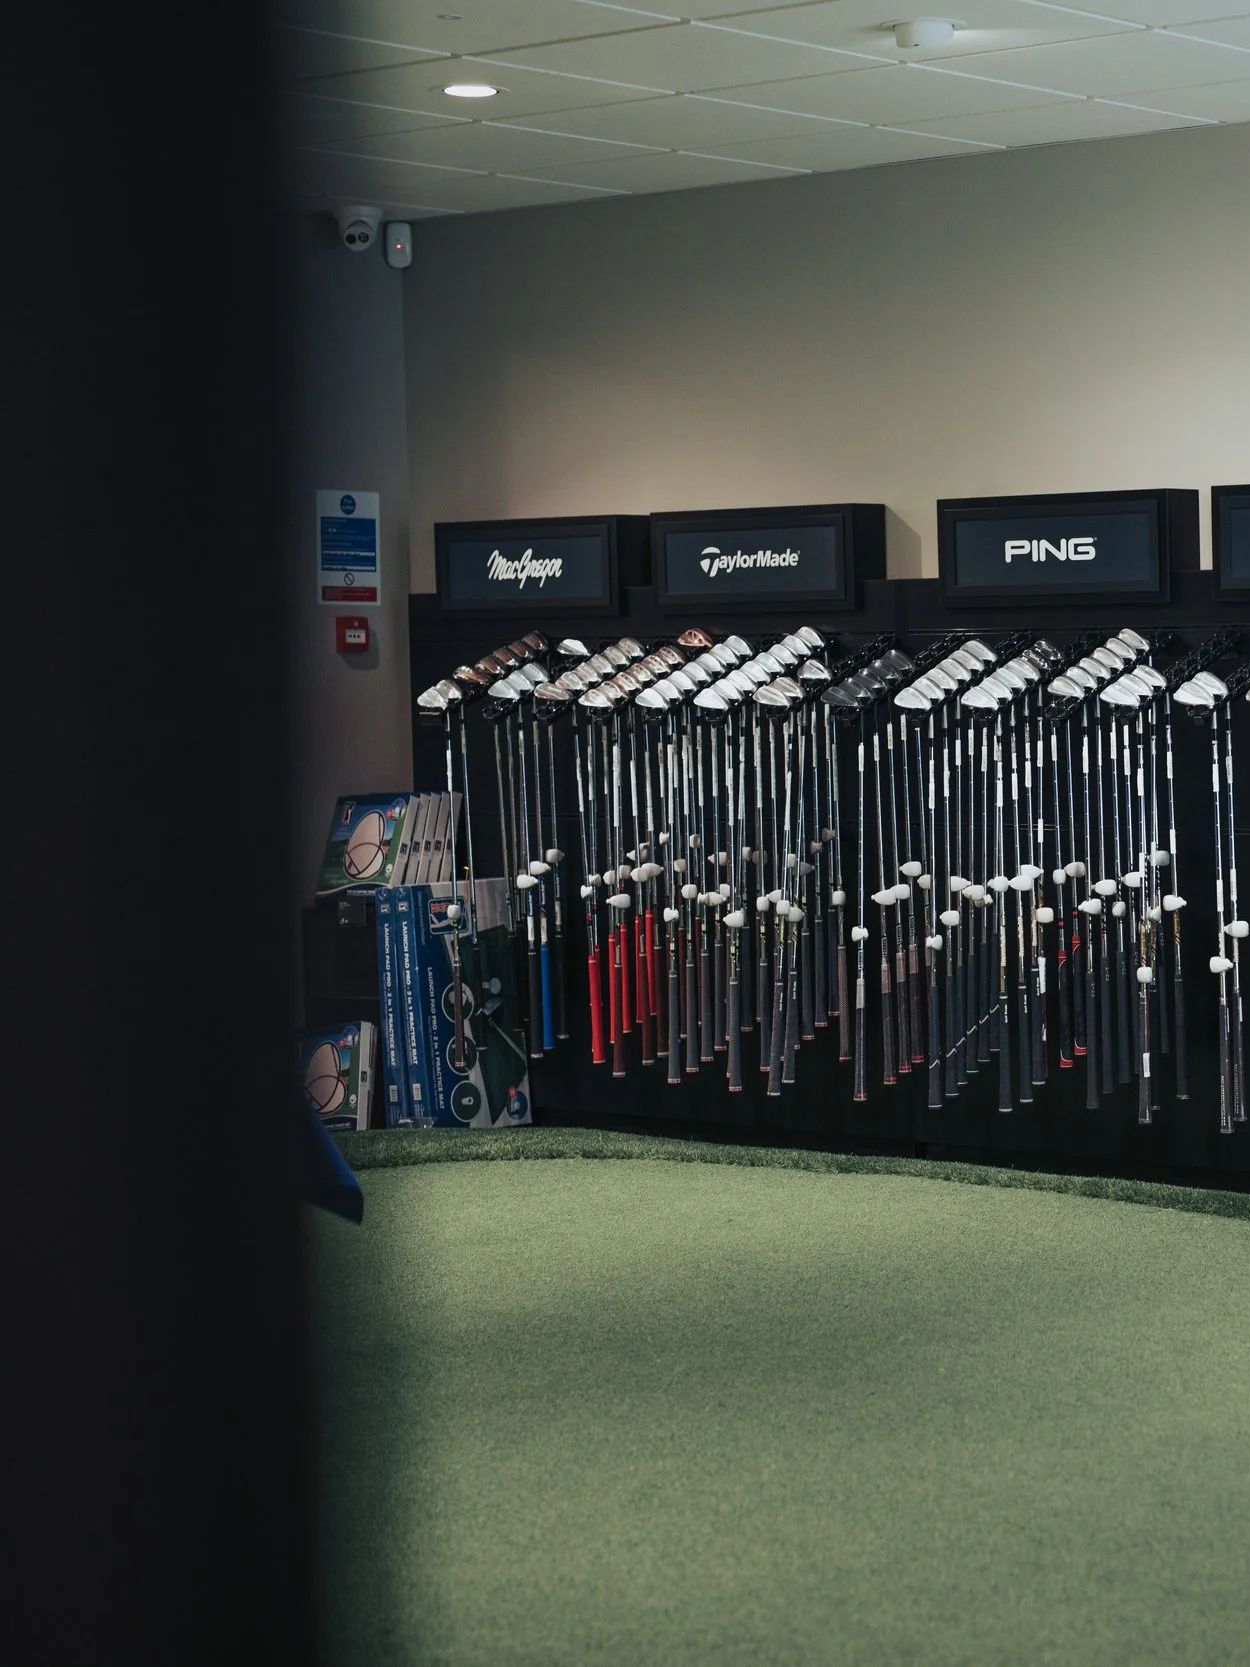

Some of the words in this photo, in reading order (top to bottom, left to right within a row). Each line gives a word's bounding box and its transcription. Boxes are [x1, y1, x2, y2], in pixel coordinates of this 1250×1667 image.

[700, 546, 799, 577] TaylorMade
[1005, 537, 1096, 563] PING
[487, 548, 562, 589] MacGregor
[408, 1012, 416, 1047] PRACTICE
